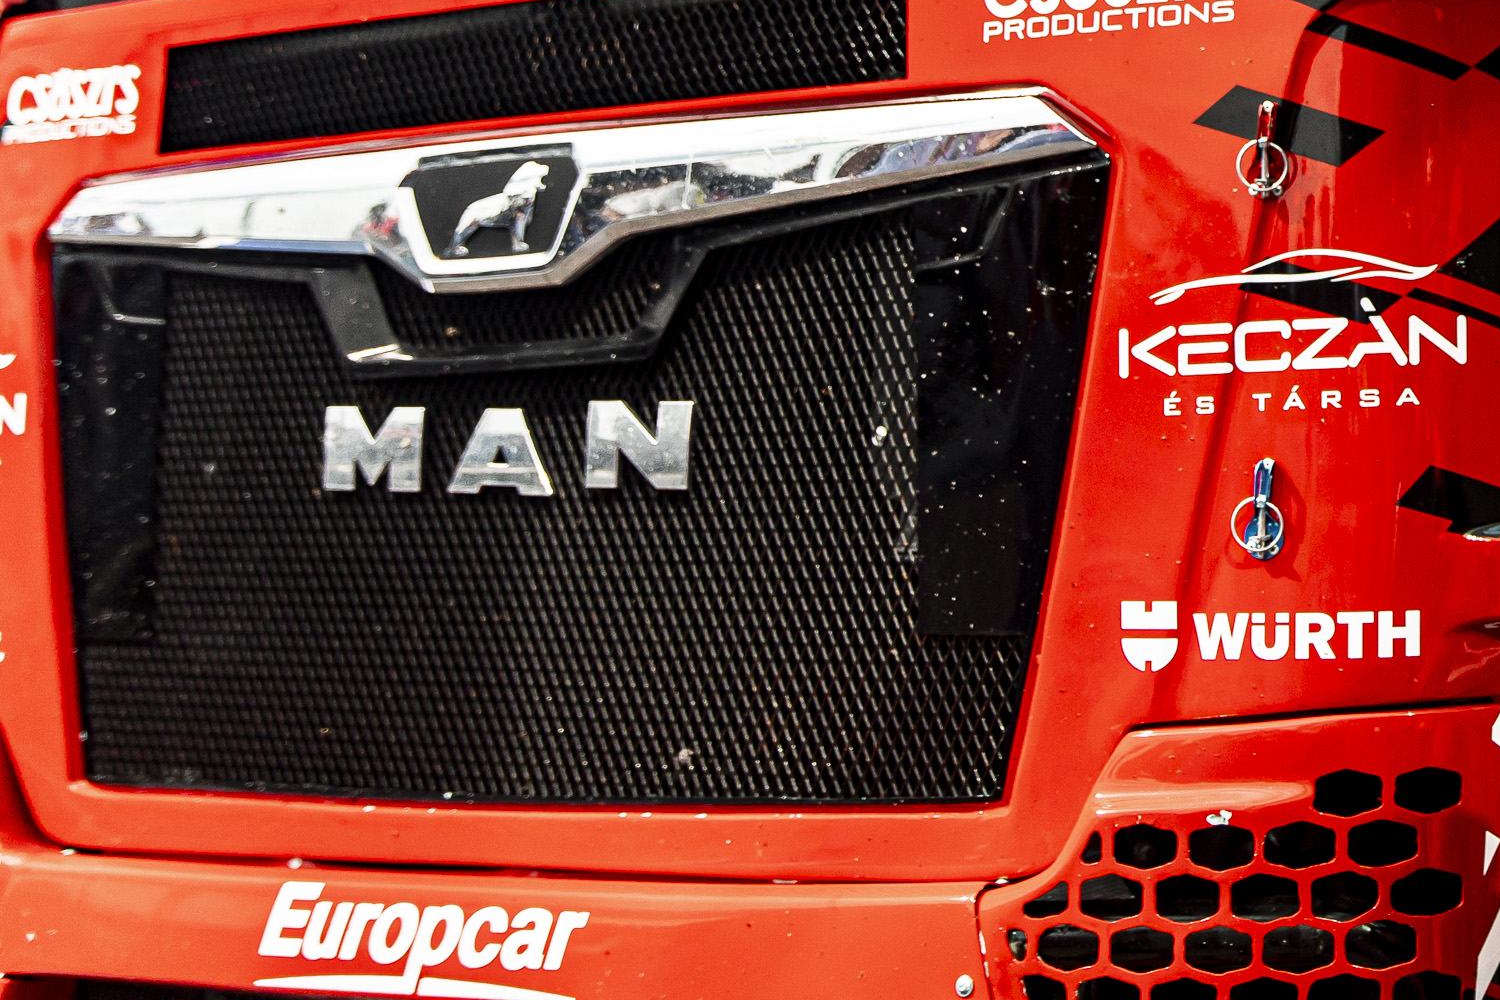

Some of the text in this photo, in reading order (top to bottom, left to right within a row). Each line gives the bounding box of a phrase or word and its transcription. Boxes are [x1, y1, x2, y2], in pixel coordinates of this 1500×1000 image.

[983, 0, 1236, 44] PRODUCTIONS
[1163, 384, 1421, 416] ÉS TÁRSA
[323, 399, 695, 497] MAN
[1192, 609, 1421, 661] WÜRTH
[258, 880, 591, 995] Europcar
